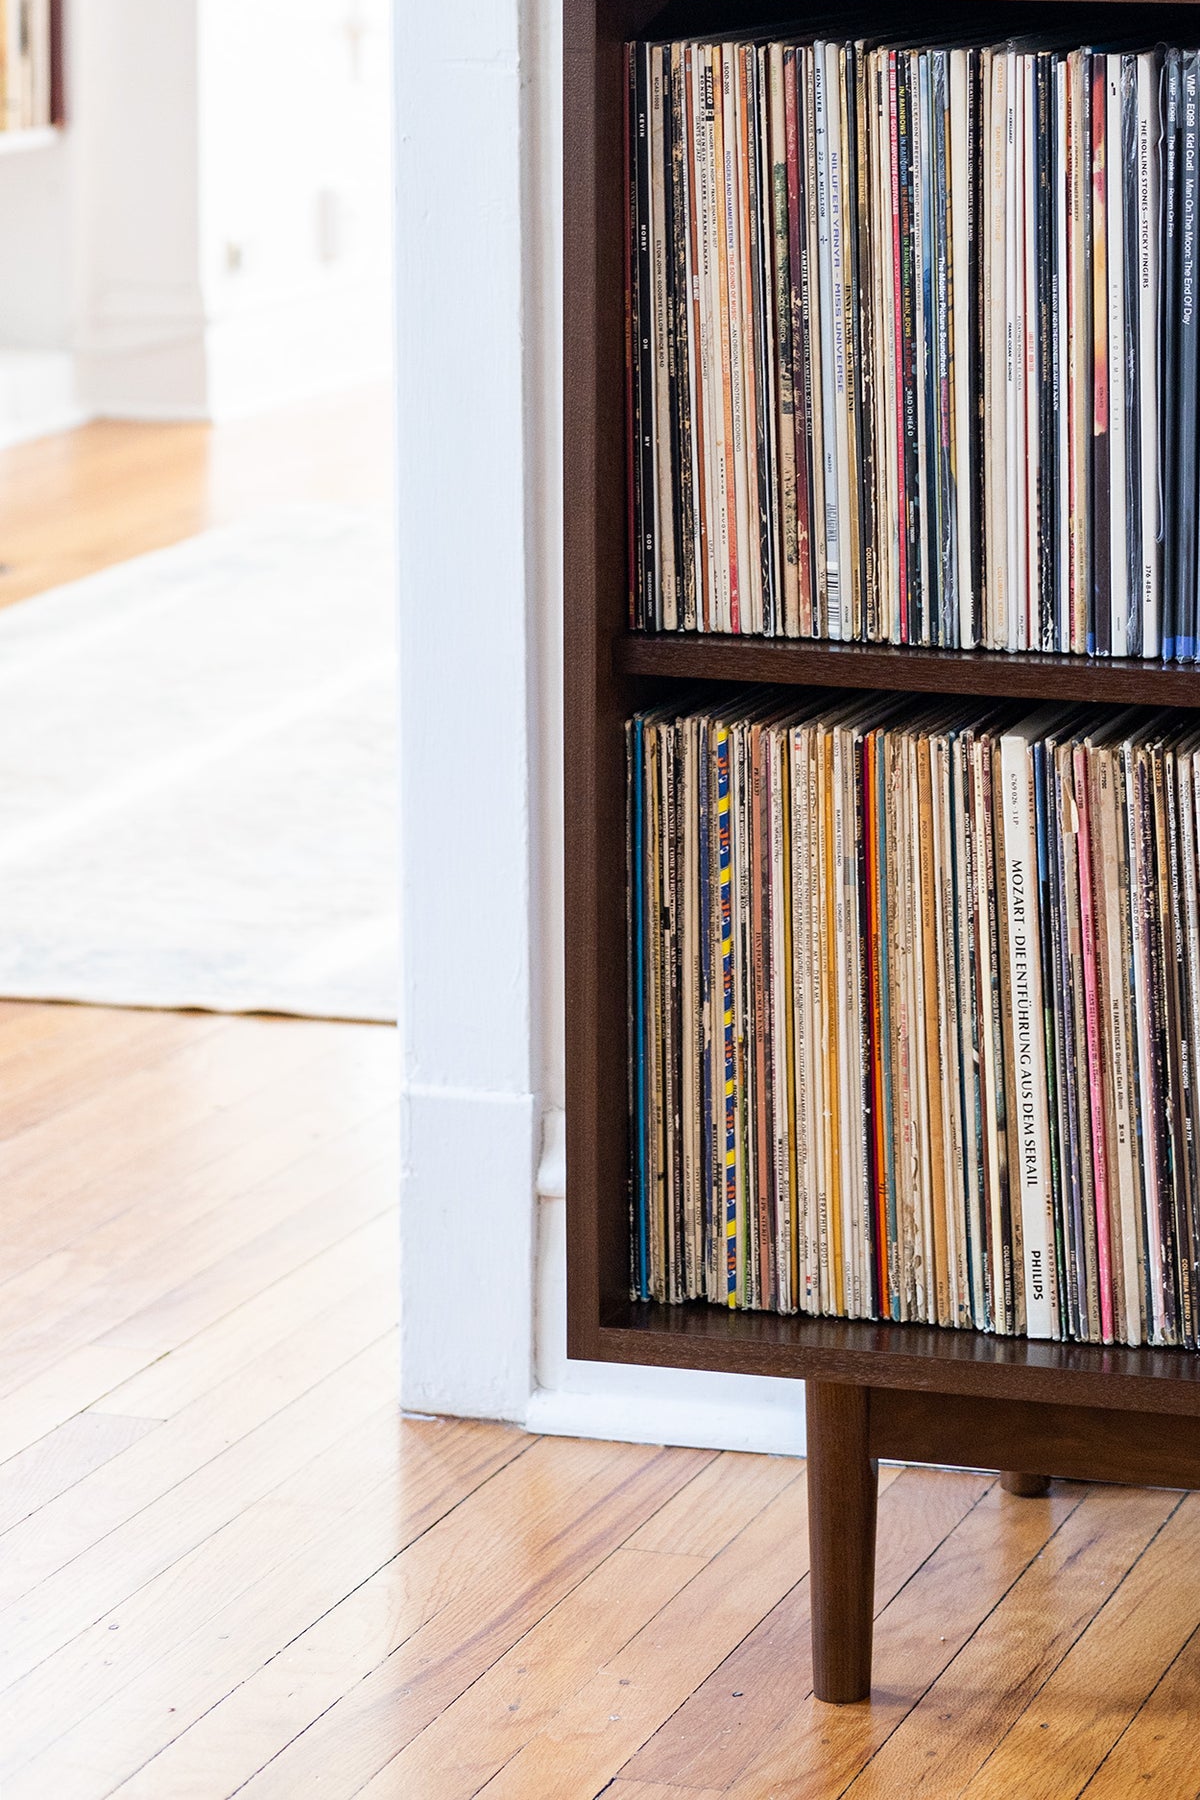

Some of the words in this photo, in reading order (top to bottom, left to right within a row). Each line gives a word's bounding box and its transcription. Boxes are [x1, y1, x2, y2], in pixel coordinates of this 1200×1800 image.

[1186, 133, 1194, 148] Kid
[1186, 150, 1194, 171] Cudi
[1185, 199, 1193, 212] On
[1184, 213, 1192, 229] The
[1184, 231, 1192, 258] Moon:
[1184, 260, 1192, 276] The
[1184, 278, 1192, 294] End
[1184, 296, 1191, 306] Of
[1183, 308, 1191, 324] Day
[643, 338, 648, 350] OH
[645, 436, 650, 447] MY
[1011, 860, 1025, 923] MOZART
[1014, 936, 1027, 958] DIE
[1016, 963, 1033, 1065] ENTFÜHRUNG
[1021, 1070, 1034, 1099] AUS
[1023, 1103, 1035, 1136] DEM
[1024, 1140, 1038, 1187] SERAIL
[1031, 1251, 1043, 1300] PHILIPS
